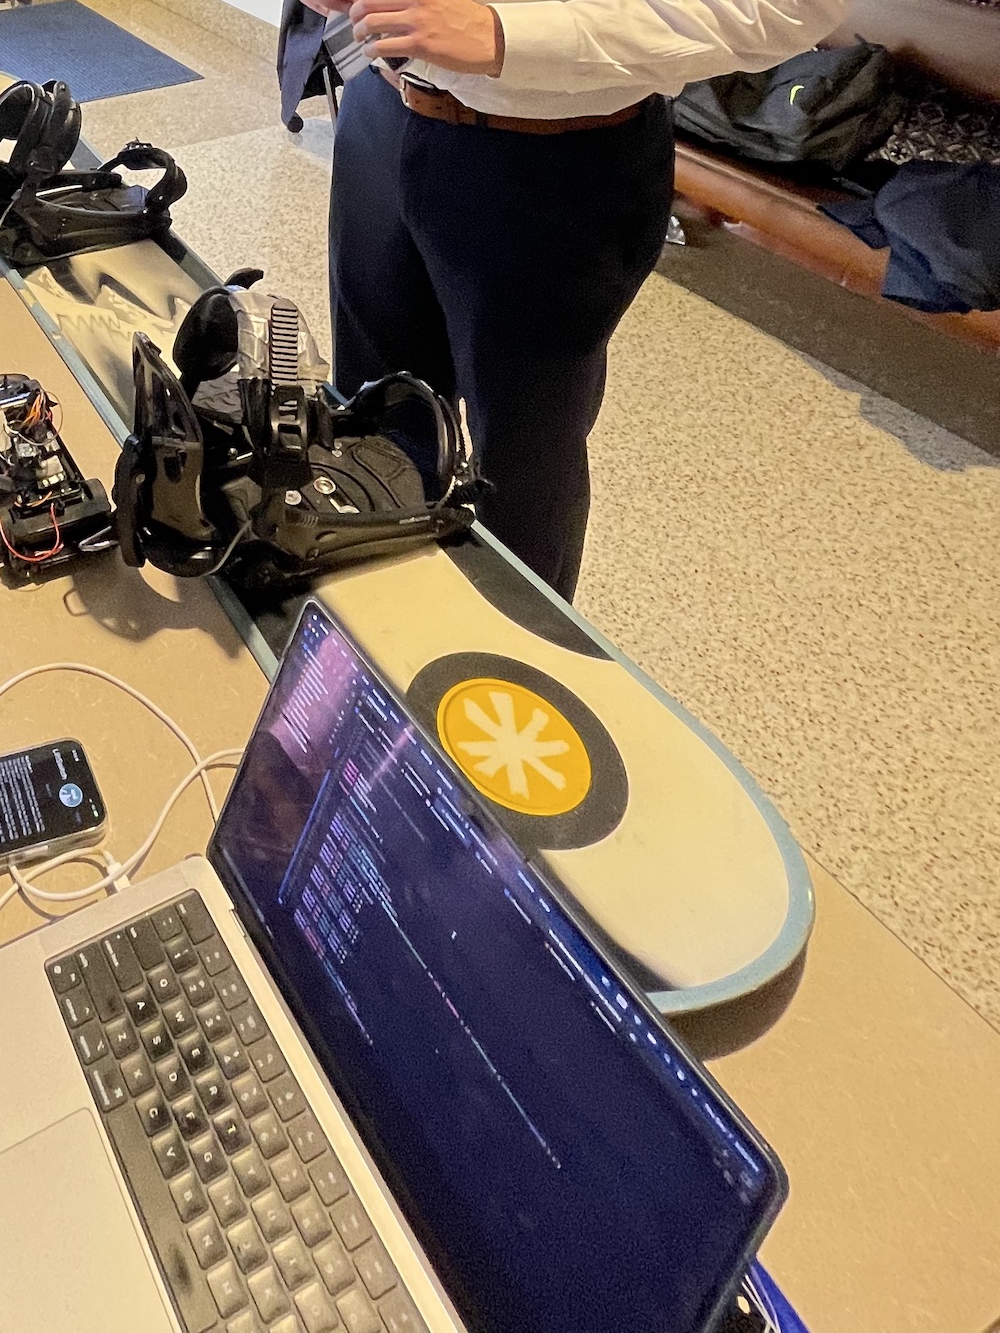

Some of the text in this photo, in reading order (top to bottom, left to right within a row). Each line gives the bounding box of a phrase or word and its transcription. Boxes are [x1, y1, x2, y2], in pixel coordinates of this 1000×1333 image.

[117, 1032, 127, 1042] Z
[132, 1068, 143, 1079] X
[148, 1107, 159, 1118] C
[166, 1147, 176, 1158] V
[136, 1001, 146, 1011] A
[152, 1035, 162, 1046] S
[168, 1072, 178, 1082] D
[203, 1152, 213, 1163] G
[175, 1011, 186, 1023] W
[191, 1048, 201, 1058] E
[209, 1085, 218, 1096] R
[227, 1124, 237, 1135] T
